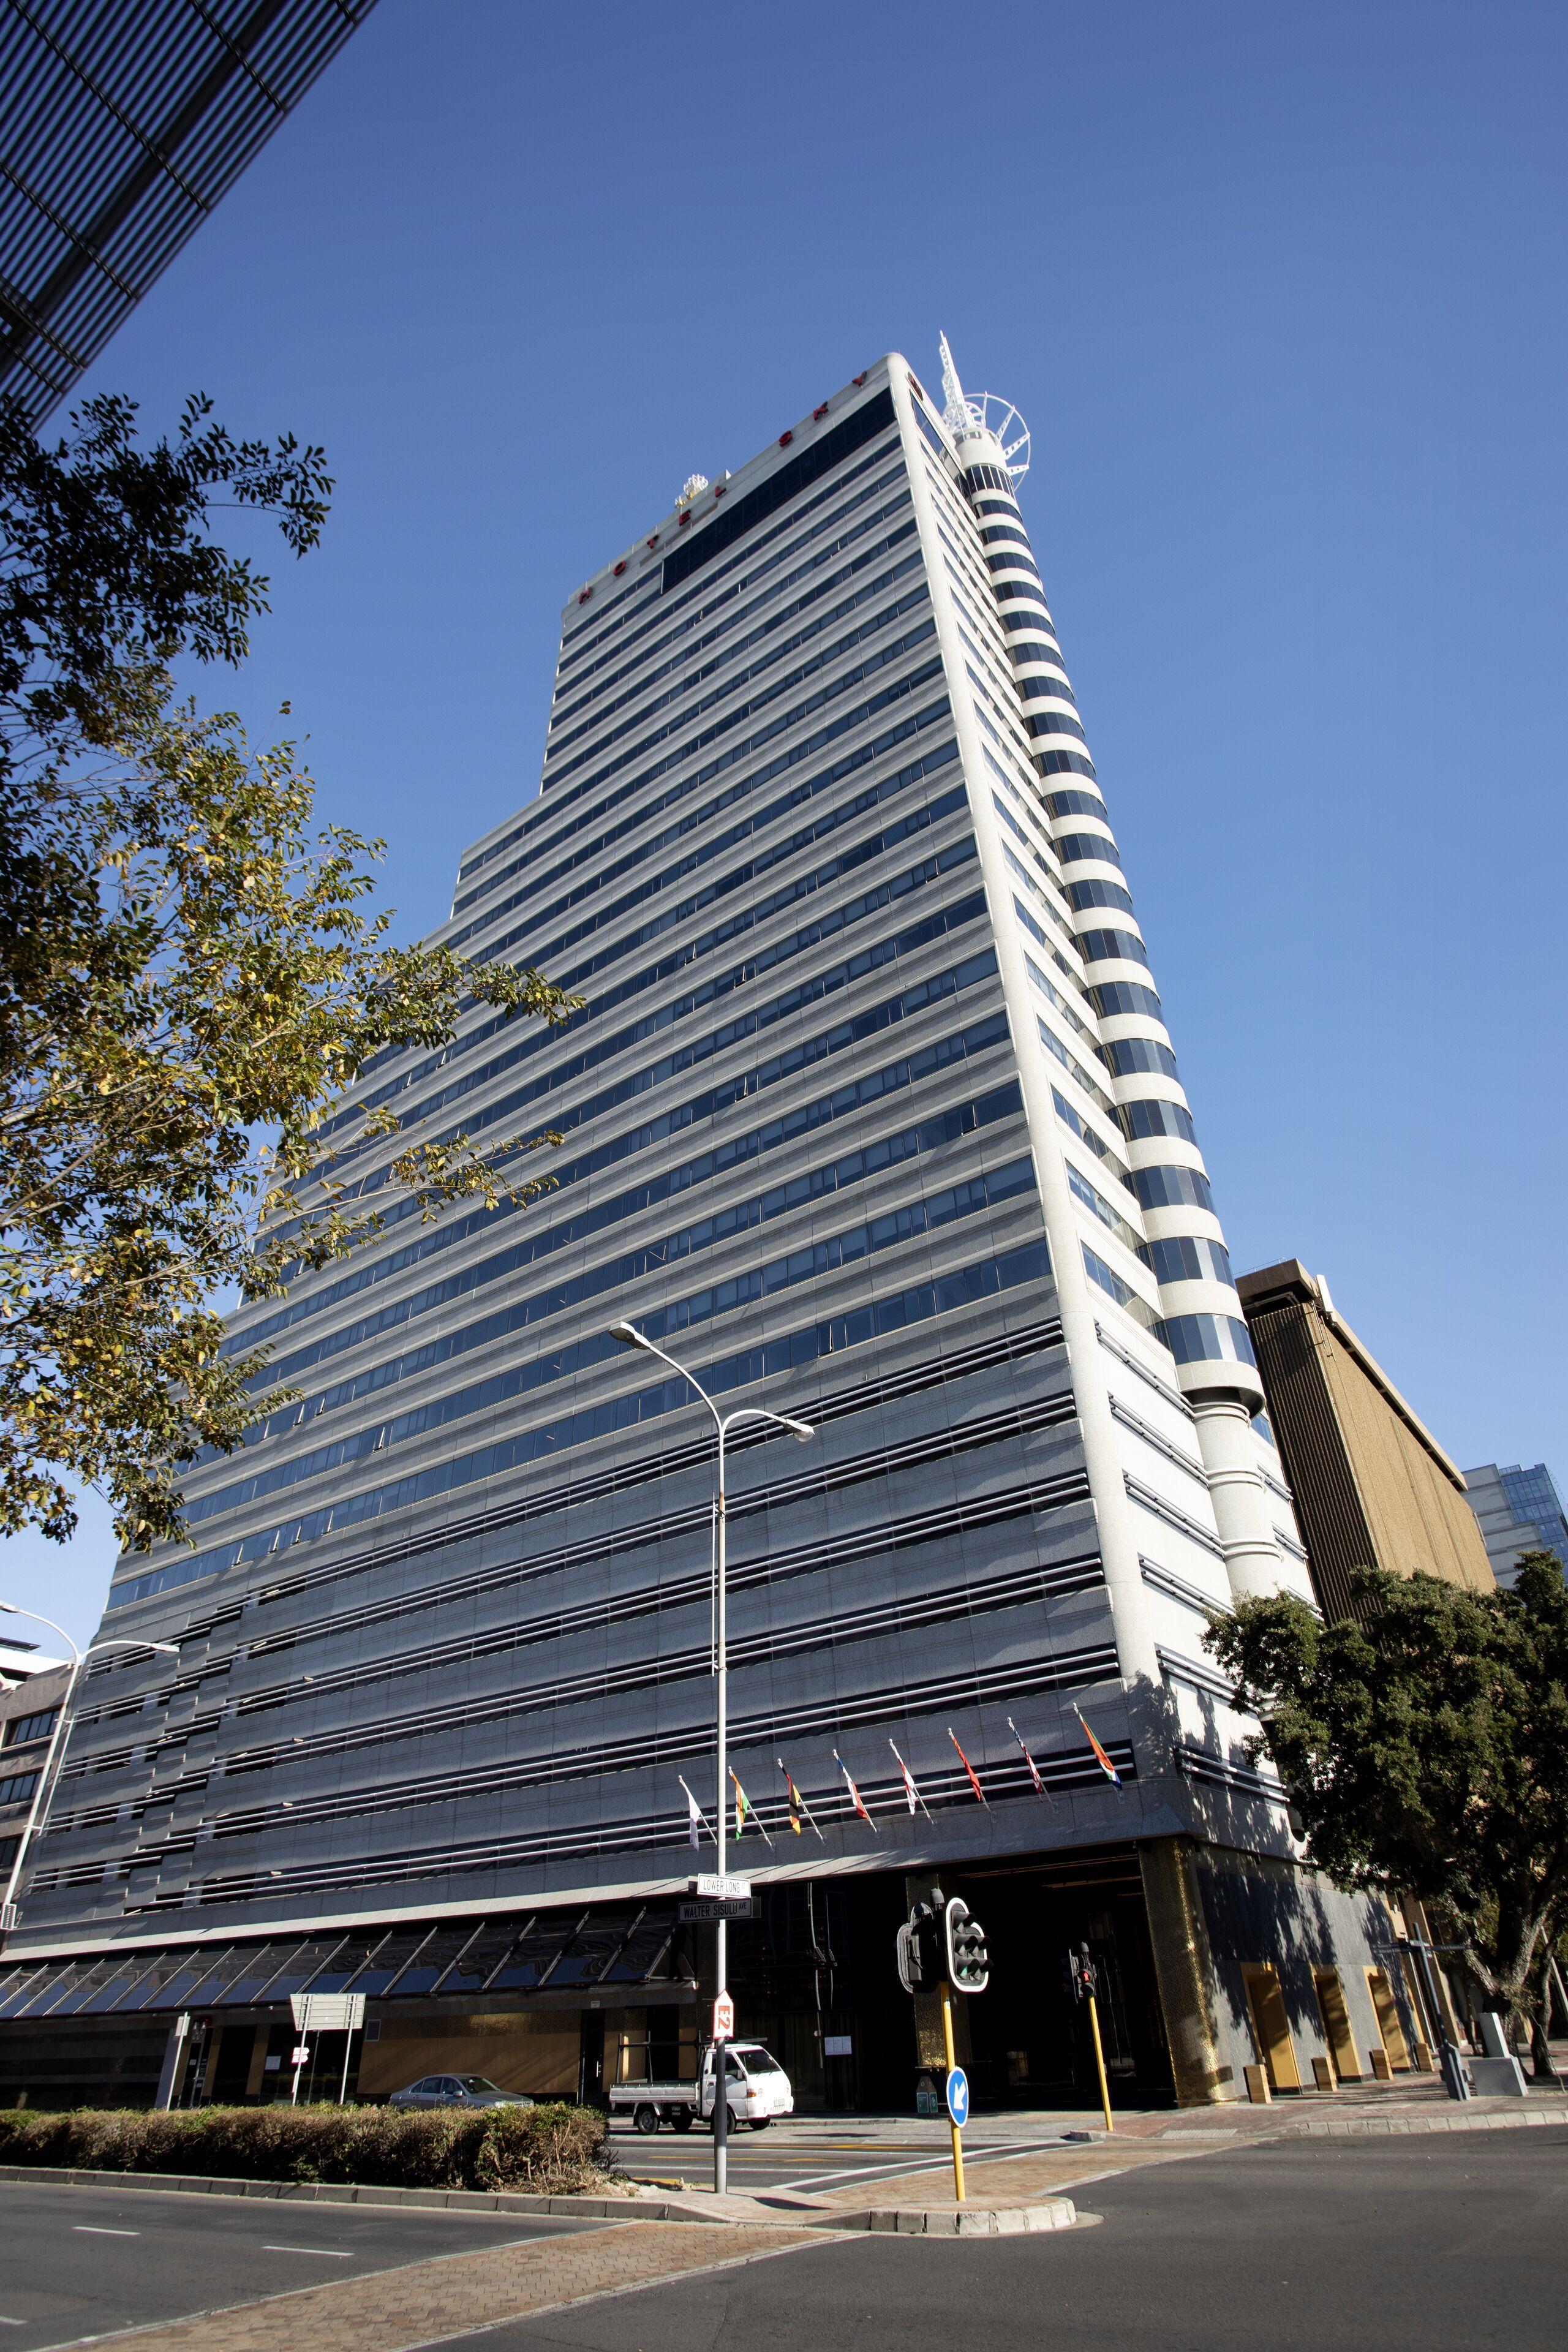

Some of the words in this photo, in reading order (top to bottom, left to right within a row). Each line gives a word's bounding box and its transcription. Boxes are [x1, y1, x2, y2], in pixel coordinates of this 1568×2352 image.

[579, 486, 726, 605] HOTEL
[778, 371, 867, 448] SKY
[703, 1879, 724, 1892] LOWER
[726, 1881, 740, 1893] LONG
[684, 1905, 710, 1918] WALTER
[714, 1902, 737, 1916] SISULU
[718, 2005, 731, 2030] E2
